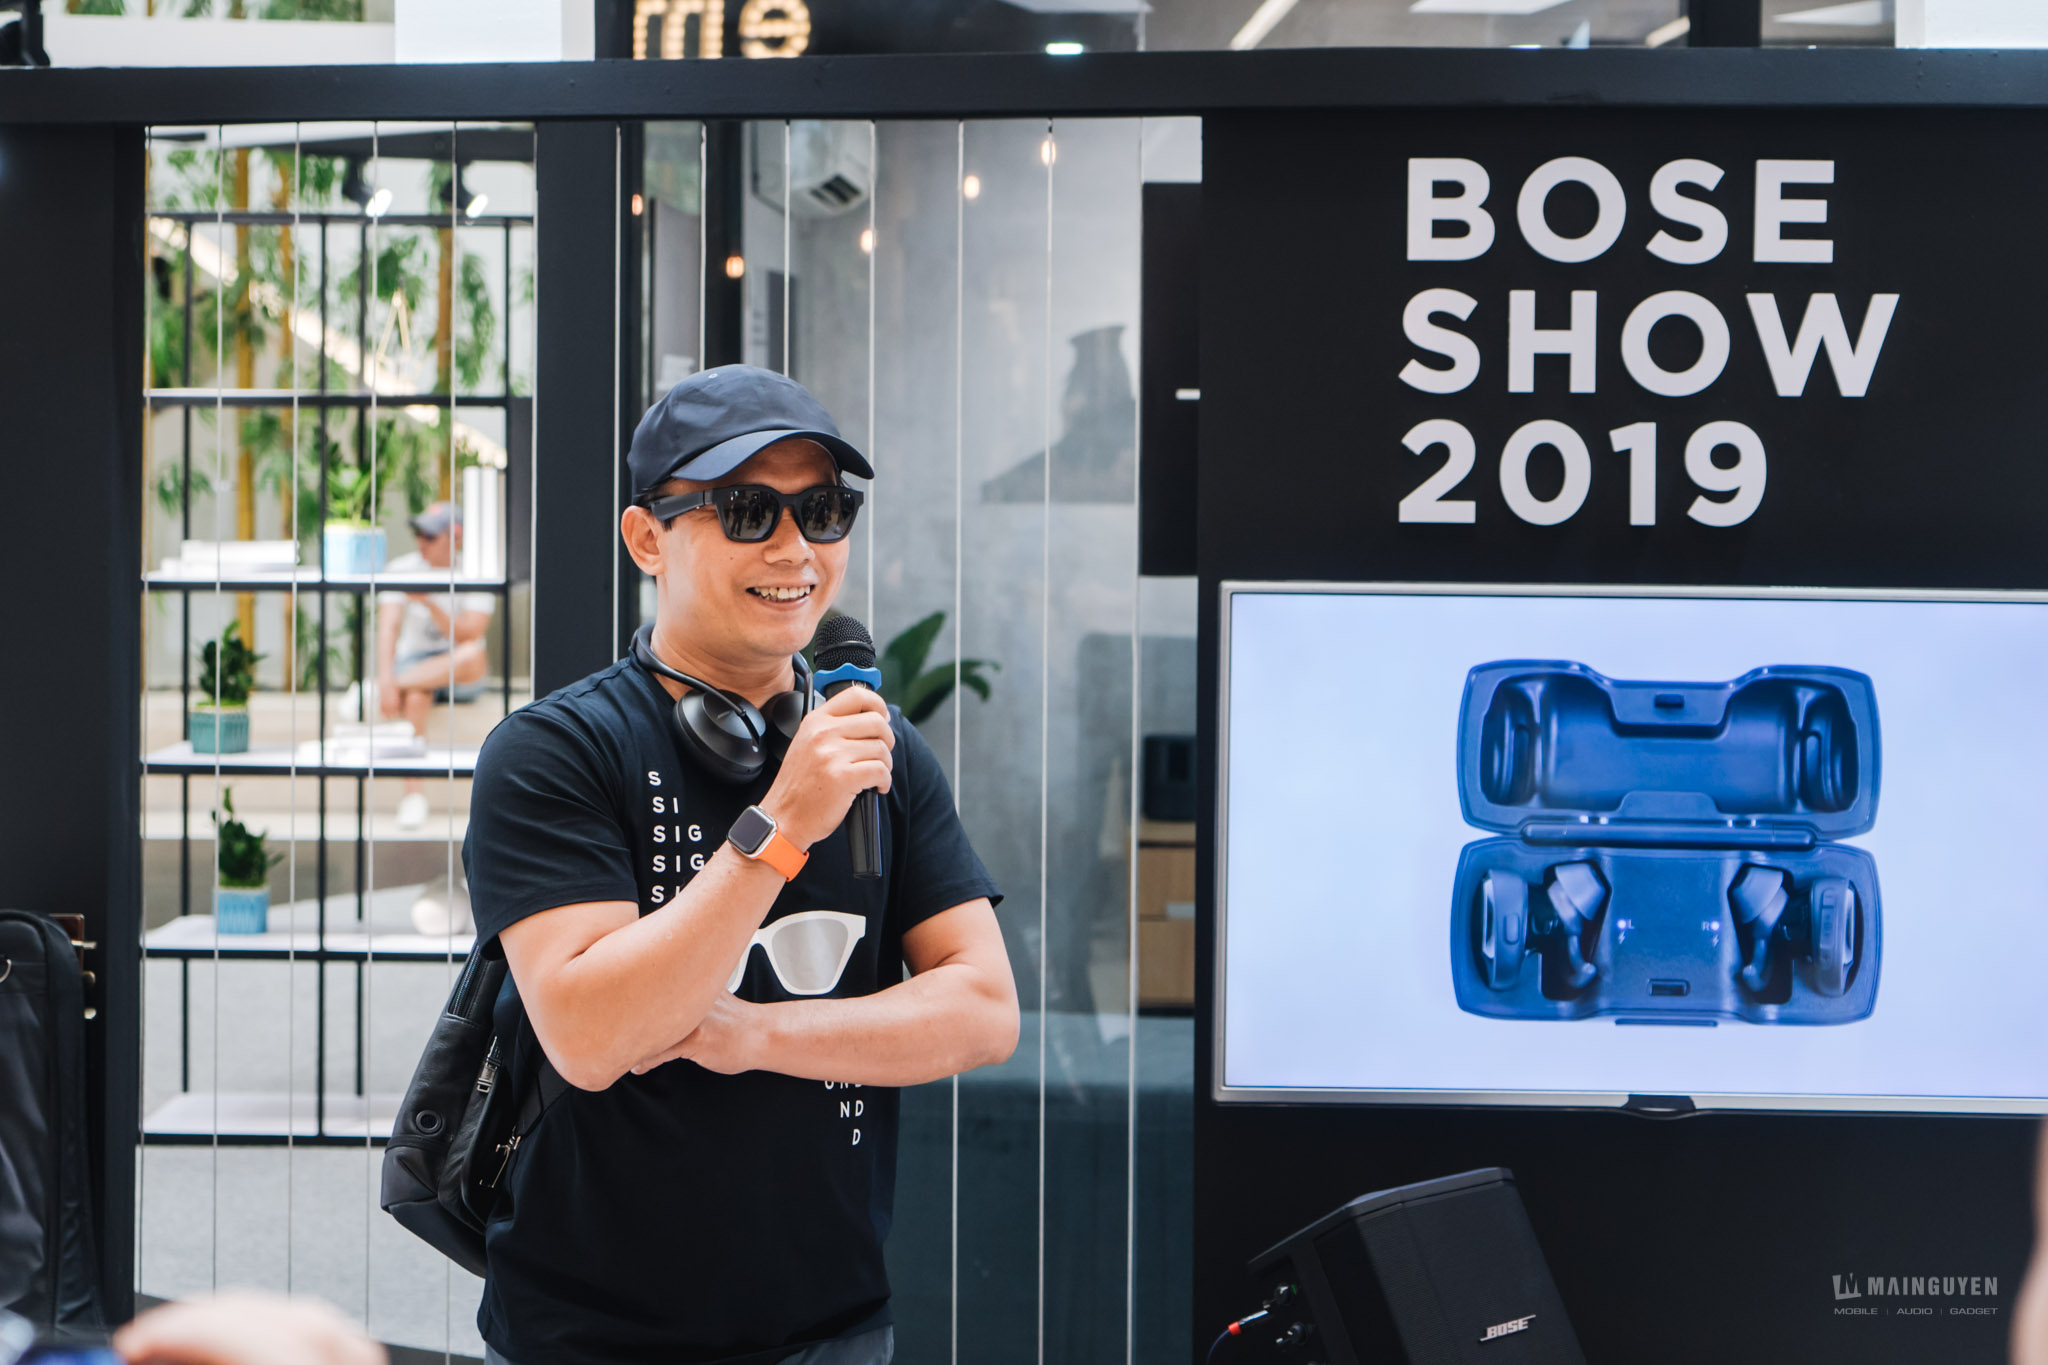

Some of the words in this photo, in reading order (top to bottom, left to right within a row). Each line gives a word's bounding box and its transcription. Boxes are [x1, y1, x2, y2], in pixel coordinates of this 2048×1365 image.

[1406, 156, 1835, 265] BOSE
[1398, 288, 1900, 397] SHOW
[1398, 418, 1767, 527] 2019
[648, 770, 662, 786] S
[652, 796, 679, 814] SI
[653, 824, 703, 843] SIG
[652, 852, 716, 873] SIG
[840, 1099, 864, 1118] ND
[852, 1128, 861, 1146] D
[1480, 1314, 1536, 1342] BOSE
